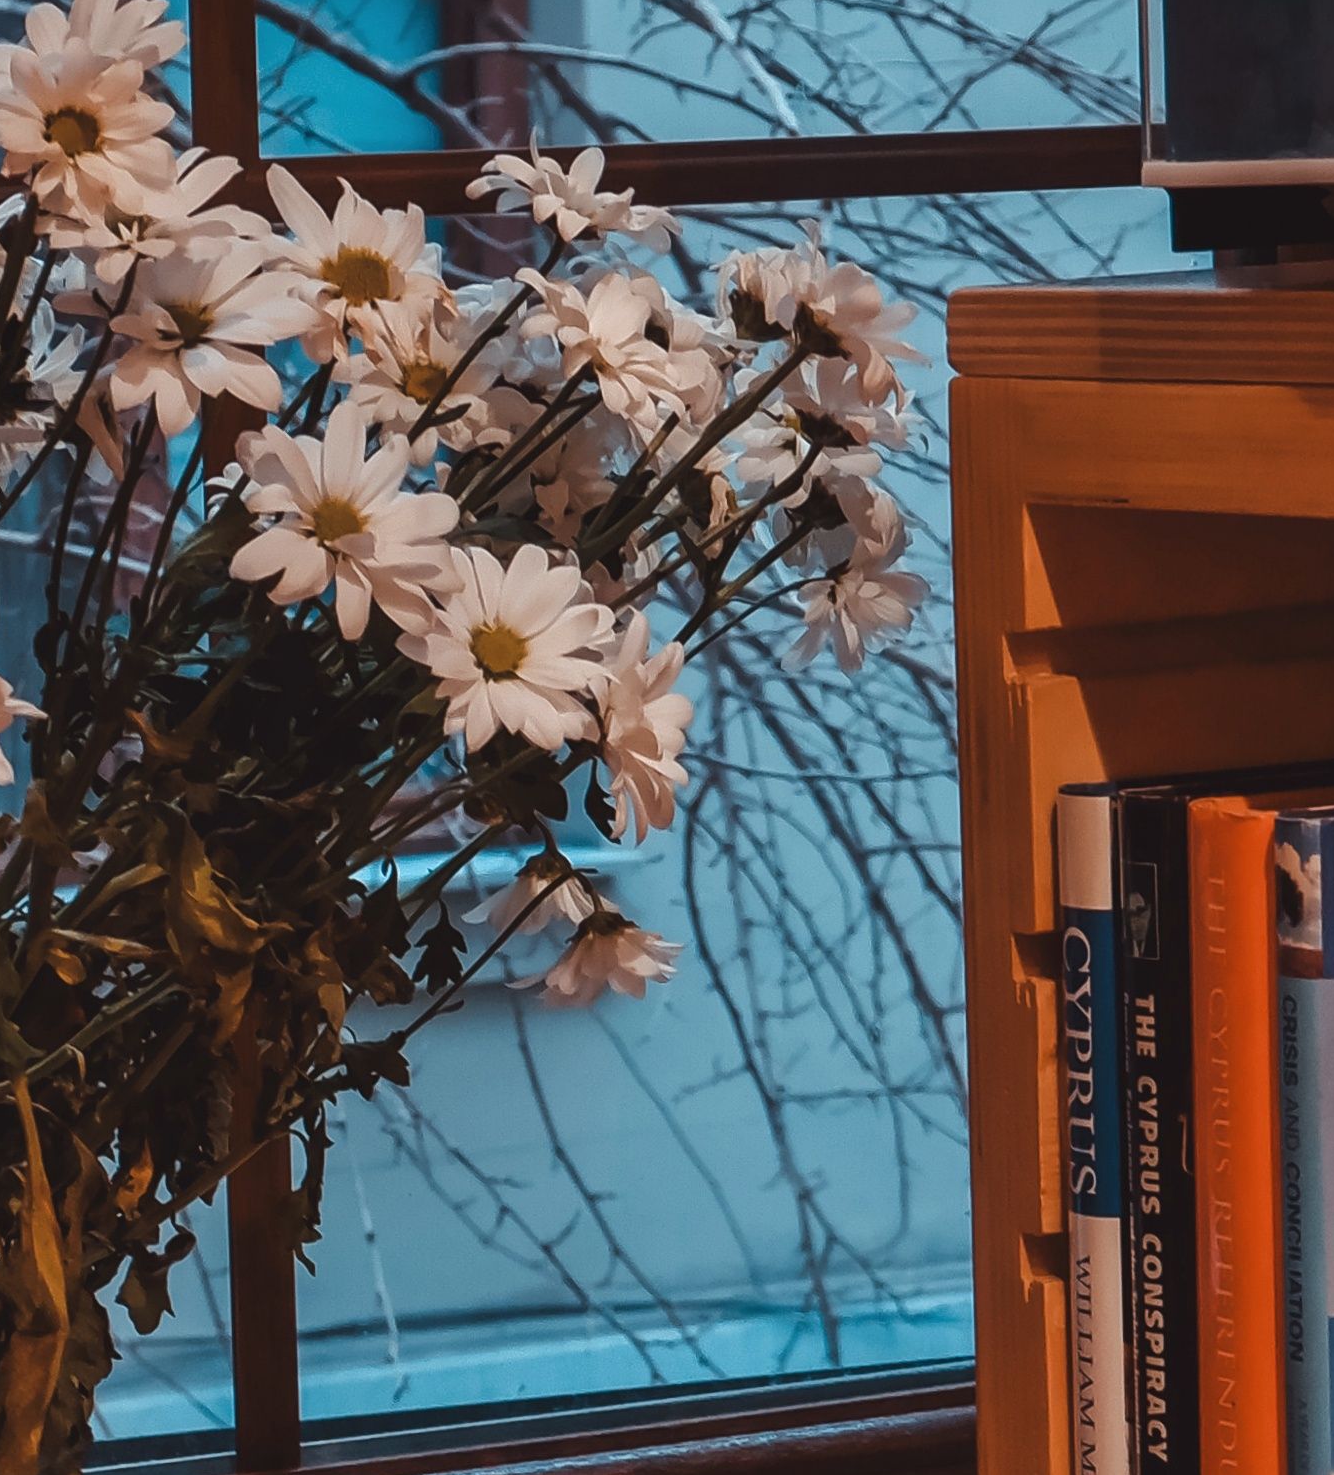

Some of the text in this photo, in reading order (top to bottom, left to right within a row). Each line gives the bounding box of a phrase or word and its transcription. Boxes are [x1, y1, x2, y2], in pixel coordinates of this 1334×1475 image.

[1061, 926, 1096, 1195] CYPRUS
[1075, 1255, 1095, 1429] WILLIAM
[1135, 995, 1167, 1463] THE CYPRUS CONSPIRACY
